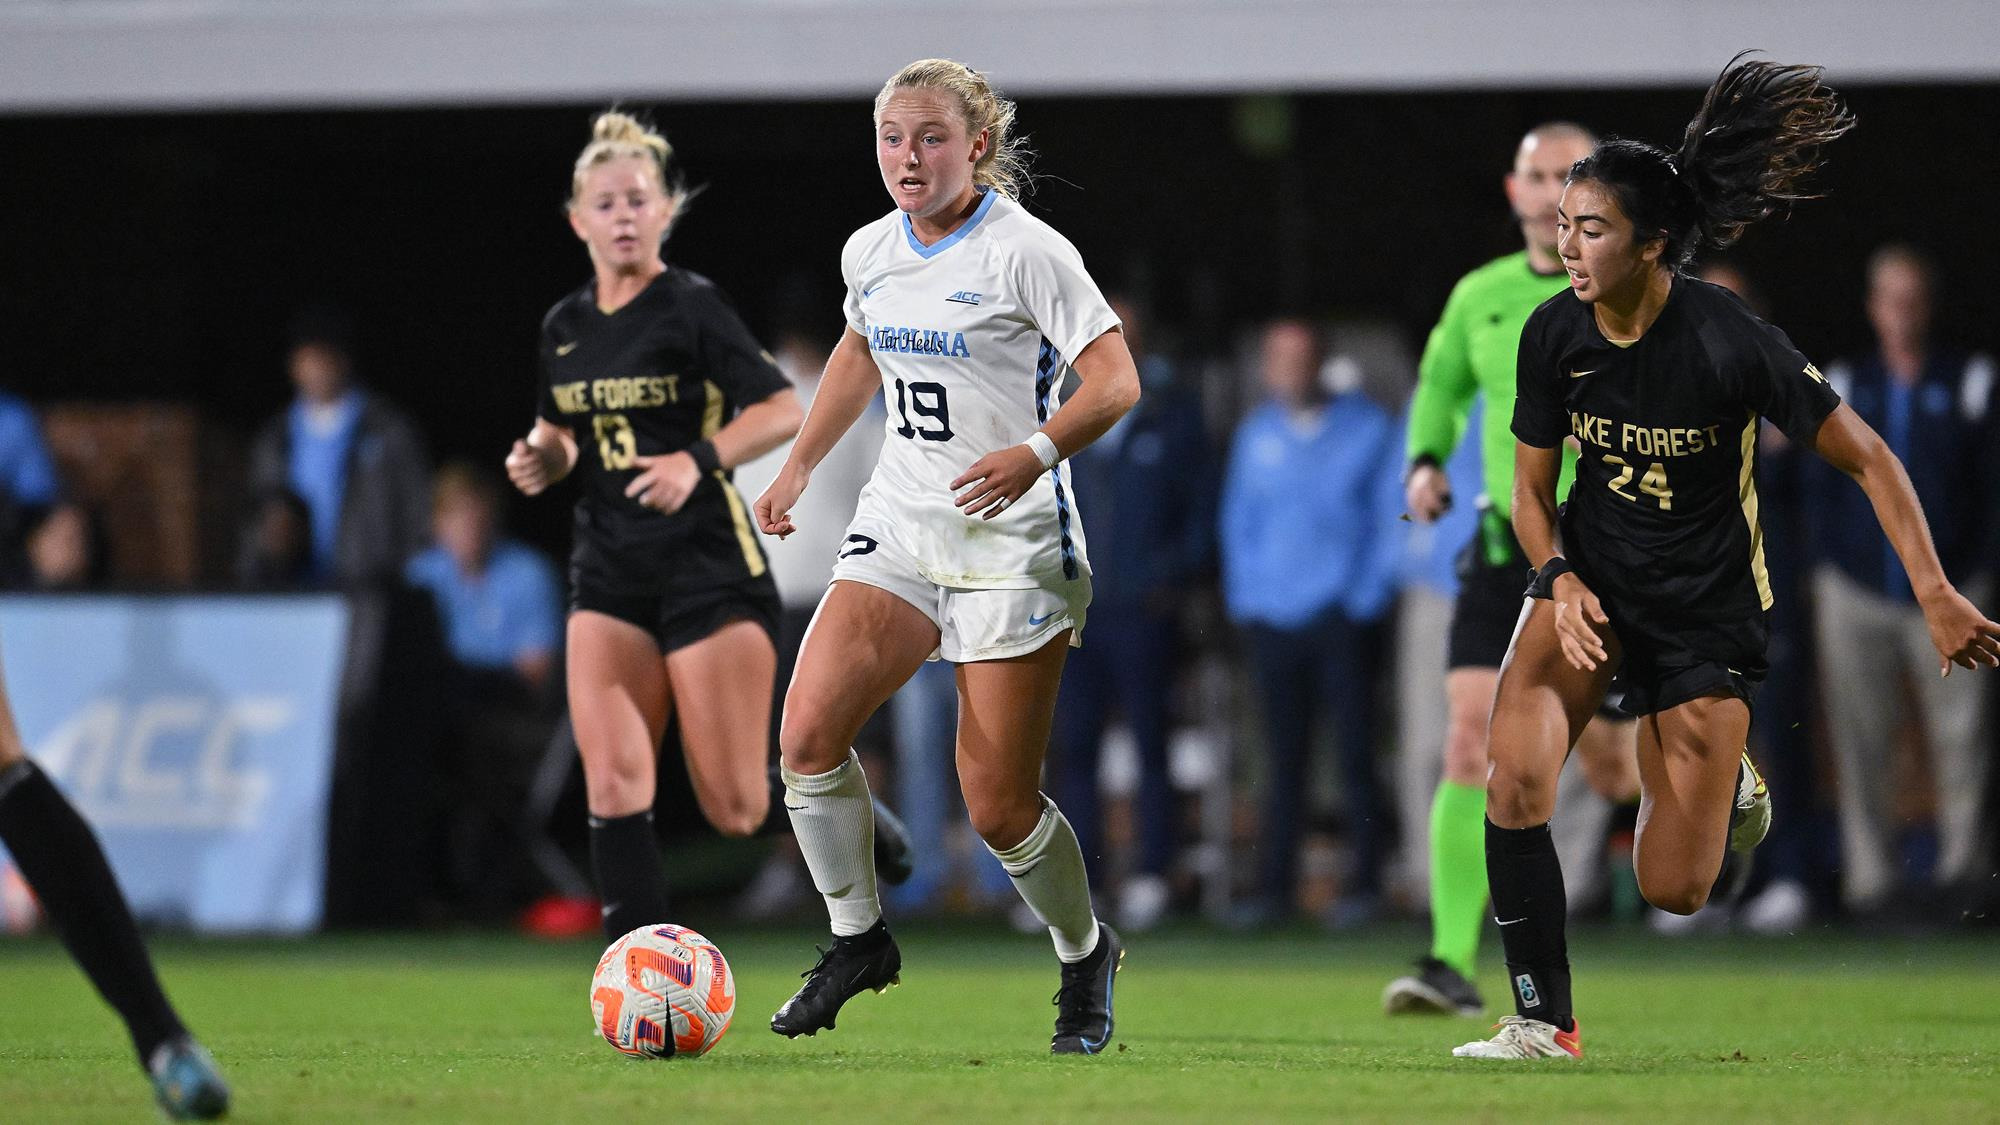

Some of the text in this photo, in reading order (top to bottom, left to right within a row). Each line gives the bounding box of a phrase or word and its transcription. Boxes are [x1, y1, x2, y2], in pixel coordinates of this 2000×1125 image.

[948, 290, 983, 303] ACC
[866, 324, 970, 358] CAROLINA
[876, 330, 944, 353] Tar Heels
[592, 374, 678, 410] FOREST
[895, 378, 955, 442] 19
[592, 413, 637, 471] 13
[1571, 412, 1720, 457] AKE FOREST
[1601, 454, 1673, 511] 24
[35, 697, 293, 800] ACC
